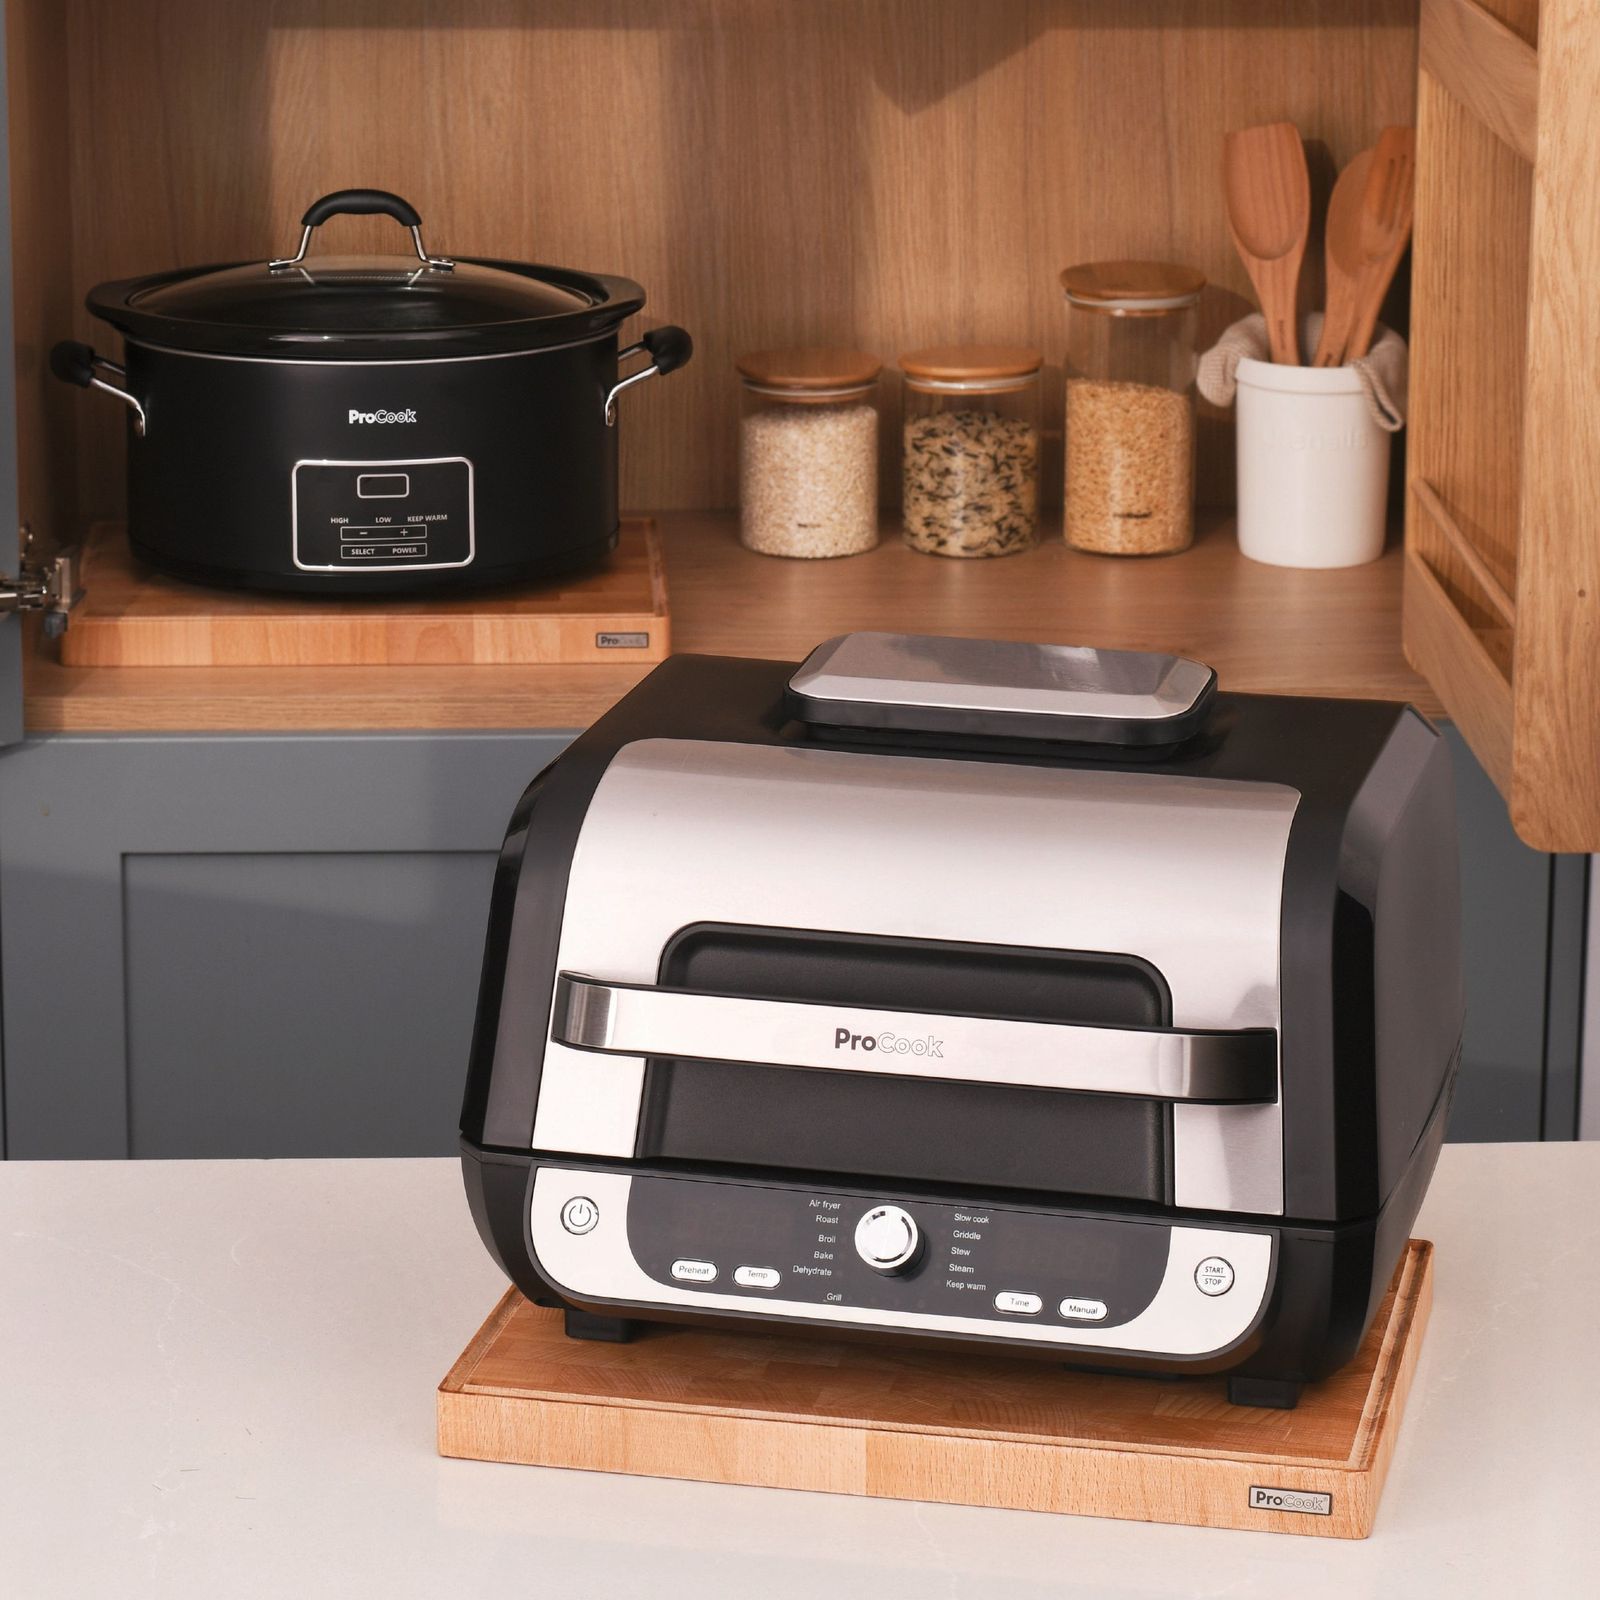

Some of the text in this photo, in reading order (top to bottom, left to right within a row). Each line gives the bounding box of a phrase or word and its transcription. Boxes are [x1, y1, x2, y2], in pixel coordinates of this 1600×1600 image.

[348, 408, 417, 424] ProCook
[834, 1027, 944, 1058] ProCook
[808, 1200, 841, 1210] Air fryer
[815, 1214, 839, 1224] Roast
[954, 1213, 990, 1224] Slow cook
[818, 1234, 836, 1243] Broil
[952, 1229, 981, 1240] Griddle
[813, 1251, 834, 1260] Bake
[950, 1246, 971, 1256] Stew
[678, 1265, 710, 1275] Preheat
[792, 1265, 832, 1276] Dehydrate
[948, 1263, 975, 1273] Steam
[1205, 1266, 1224, 1274] START
[747, 1270, 768, 1279] Temp
[945, 1279, 987, 1291] Keep warm
[1204, 1278, 1222, 1286] STOP
[826, 1292, 842, 1302] Grill
[1010, 1298, 1030, 1307] Time
[1068, 1304, 1098, 1315] Manual
